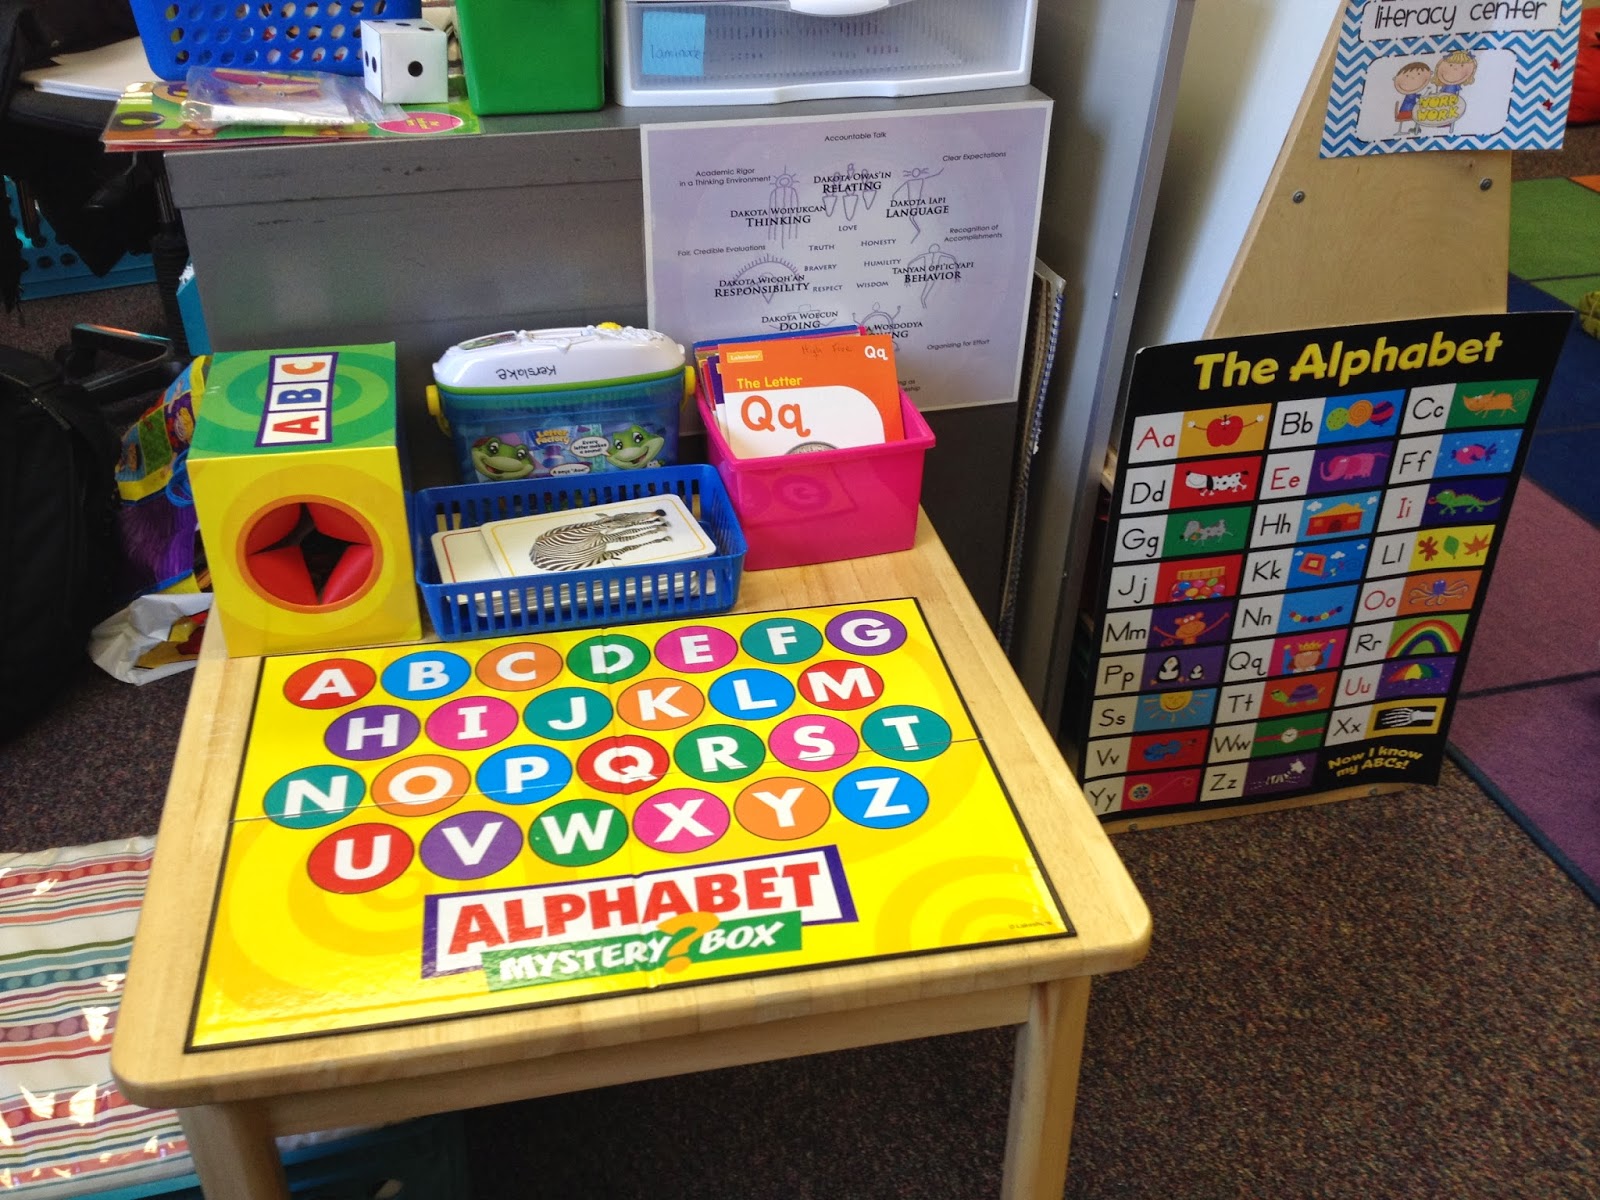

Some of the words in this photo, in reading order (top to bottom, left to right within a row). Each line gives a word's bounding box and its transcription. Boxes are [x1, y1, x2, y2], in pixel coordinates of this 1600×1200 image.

[1374, 3, 1457, 31] literacy
[1469, 0, 1548, 21] center
[824, 132, 871, 142] Accountable
[873, 131, 887, 139] Talk
[942, 154, 962, 162] Clear
[963, 151, 1007, 162] Expectations
[695, 168, 735, 177] Academic
[736, 168, 755, 177] Rigor
[695, 177, 725, 187] Thinking
[726, 175, 771, 184] Environment
[822, 181, 882, 194] RELATING
[885, 205, 950, 218] LANGUAGE
[745, 215, 811, 228] THINKING
[838, 224, 858, 232] LOVE
[943, 231, 1003, 242] Accomplishments
[949, 225, 988, 235] Recognition
[693, 246, 725, 256] Credible
[725, 244, 766, 254] Evaluations
[860, 238, 897, 247] HONESTY
[804, 263, 838, 272] BRAVERY
[863, 258, 902, 267] HUMILITY
[856, 280, 889, 288] WISDOM
[903, 271, 962, 284] BEHAVIOR
[714, 282, 810, 298] RESPONSIBILITY
[779, 320, 821, 332] DOING
[926, 342, 962, 351] Organizing
[973, 338, 990, 346] Effort
[864, 345, 888, 361] Qq
[1193, 351, 1279, 391] The
[1288, 331, 1503, 387] Alphabet
[495, 364, 557, 381] Kerslake
[736, 377, 761, 390] The
[764, 376, 803, 389] Letter
[740, 395, 811, 438] Qq
[1136, 426, 1176, 451] Aa
[1280, 411, 1314, 436] Bb
[1412, 397, 1444, 420] Cc
[1130, 479, 1166, 505] Dd
[1270, 467, 1301, 491] Ee
[1398, 450, 1433, 475] Ff
[1121, 528, 1159, 558] Gg
[1259, 513, 1291, 536] Hh
[1396, 497, 1413, 519] Ii
[1117, 575, 1148, 604] Jj
[1252, 559, 1282, 582] Kk
[1381, 542, 1405, 566] Ll
[1105, 621, 1147, 643] Mm
[1241, 606, 1272, 628] Nn
[1364, 590, 1396, 611] Oo
[300, 668, 357, 701] A
[408, 660, 450, 692] B
[495, 651, 537, 682] C
[589, 643, 635, 675] D
[679, 634, 714, 665] E
[765, 625, 798, 656] F
[840, 617, 892, 648] G
[1103, 665, 1135, 691] Pp
[1228, 651, 1267, 676] Qq
[1354, 633, 1382, 654] Rr
[345, 713, 400, 751] H
[456, 705, 488, 740] I
[547, 696, 589, 731] J
[636, 686, 690, 722] K
[732, 678, 778, 711] L
[806, 667, 876, 703] M
[1098, 708, 1126, 727] Ss
[1227, 693, 1253, 714] Tt
[1344, 676, 1371, 697] Uu
[1096, 748, 1120, 767] Vv
[1213, 734, 1251, 754] Ww
[1332, 717, 1362, 737] Xx
[1327, 752, 1366, 770] Now
[1368, 747, 1376, 757] I
[1378, 745, 1423, 760] know
[283, 774, 349, 819] N
[387, 765, 454, 806] O
[504, 755, 550, 795] P
[592, 745, 658, 785] Q
[696, 735, 748, 773] R
[792, 725, 836, 762] S
[881, 715, 921, 751] T
[1336, 764, 1360, 777] my
[1361, 757, 1410, 770] ABCs!
[1089, 787, 1117, 812] Yy
[1209, 773, 1238, 792] Zz
[333, 834, 392, 881] U
[441, 821, 504, 866] V
[539, 808, 616, 856] W
[653, 798, 716, 844] X
[751, 787, 805, 828] Y
[854, 777, 912, 819] Z
[447, 861, 820, 955] ALPHABET
[498, 935, 673, 982] MYSTERY
[698, 920, 785, 956] BOX
